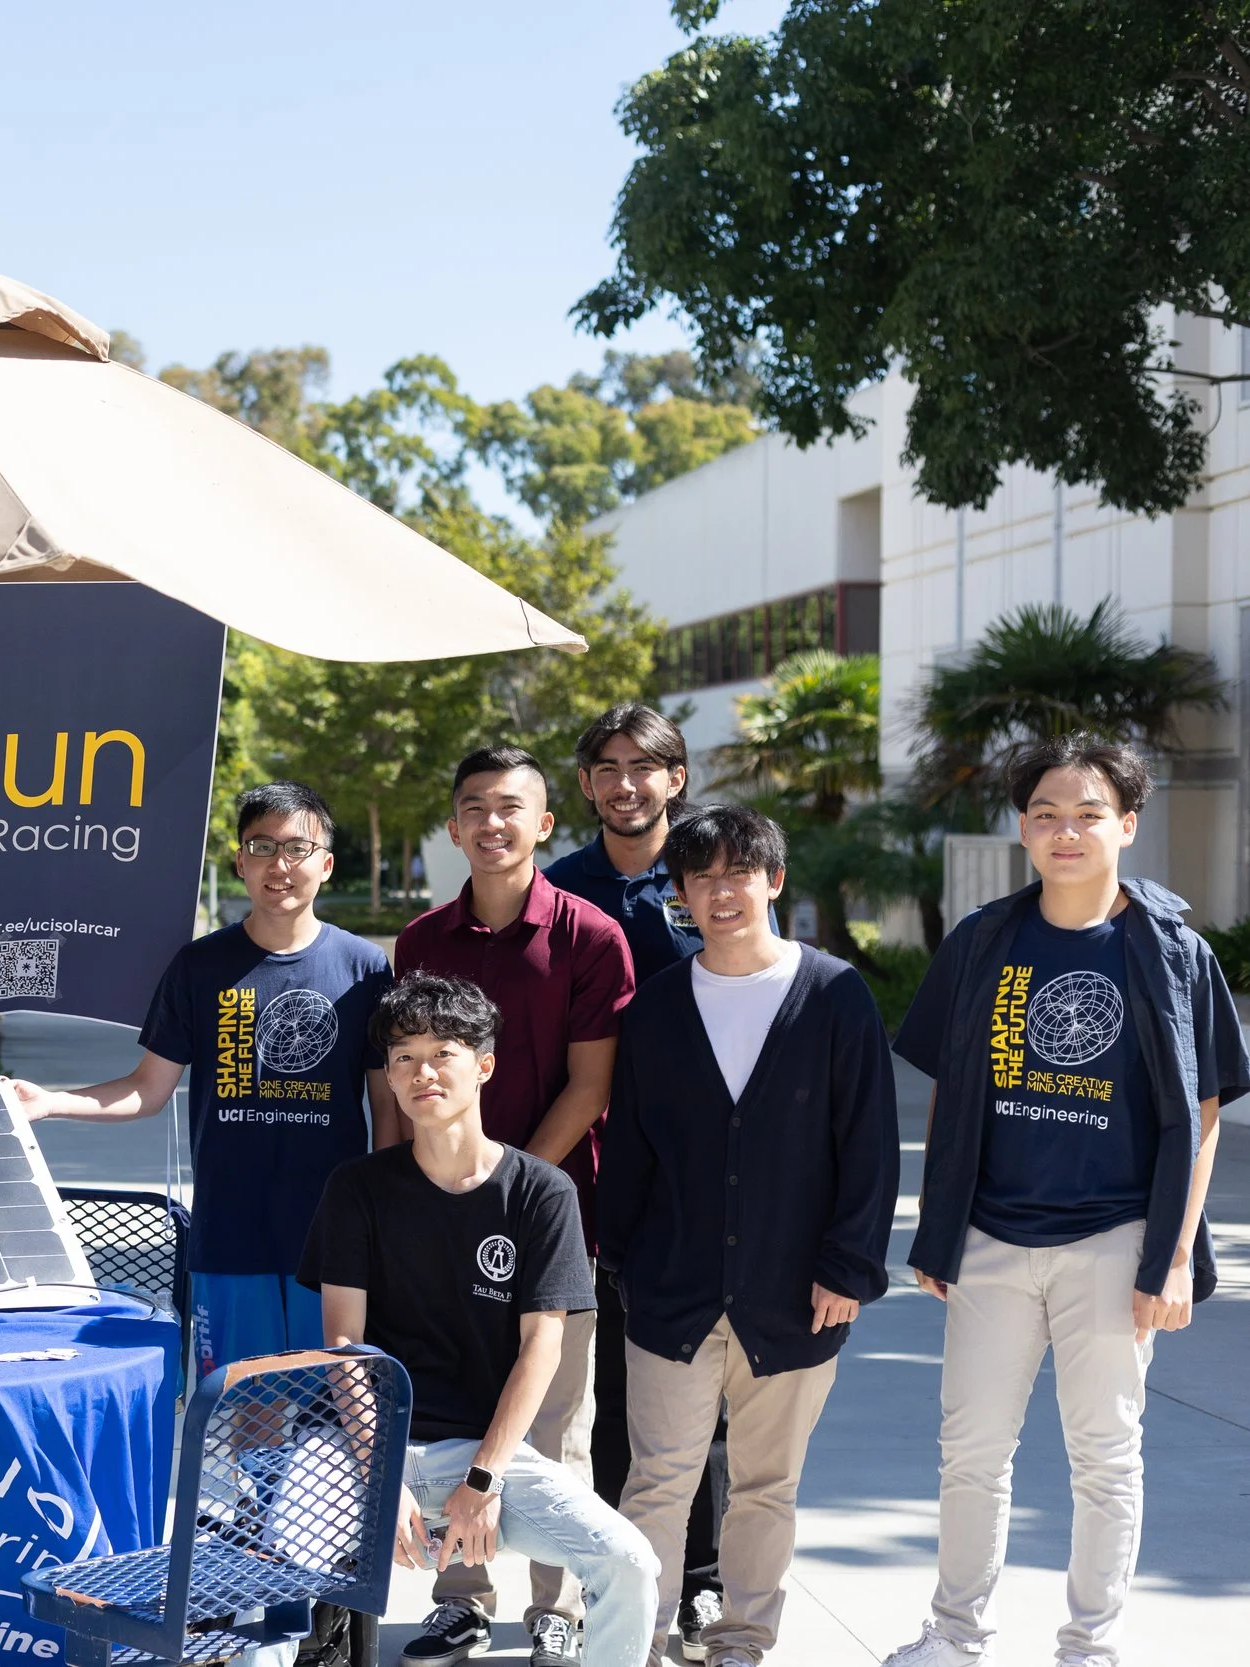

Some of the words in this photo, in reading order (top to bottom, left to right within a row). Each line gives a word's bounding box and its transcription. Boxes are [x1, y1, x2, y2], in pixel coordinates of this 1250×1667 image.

[238, 987, 256, 1059] FUTURE
[1009, 965, 1033, 1045] FUTURE
[217, 988, 239, 1099] SHAPING
[991, 965, 1014, 1088] SHAPING
[239, 1058, 252, 1098] THE
[259, 1080, 282, 1090] ONE
[283, 1080, 332, 1093] CREATIVE
[1009, 1049, 1024, 1089] THE
[1027, 1070, 1054, 1083] ONE
[1056, 1073, 1114, 1092] CREATIVE
[259, 1089, 285, 1099] MIND
[286, 1090, 299, 1099] AT
[300, 1090, 308, 1100] A
[311, 1091, 331, 1101] TIME
[1026, 1081, 1056, 1095] MIND
[1057, 1085, 1074, 1096] AT
[1075, 1086, 1085, 1097] A
[1086, 1087, 1112, 1102] TIME
[218, 1109, 245, 1122] UCI
[246, 1109, 330, 1126] Engineering
